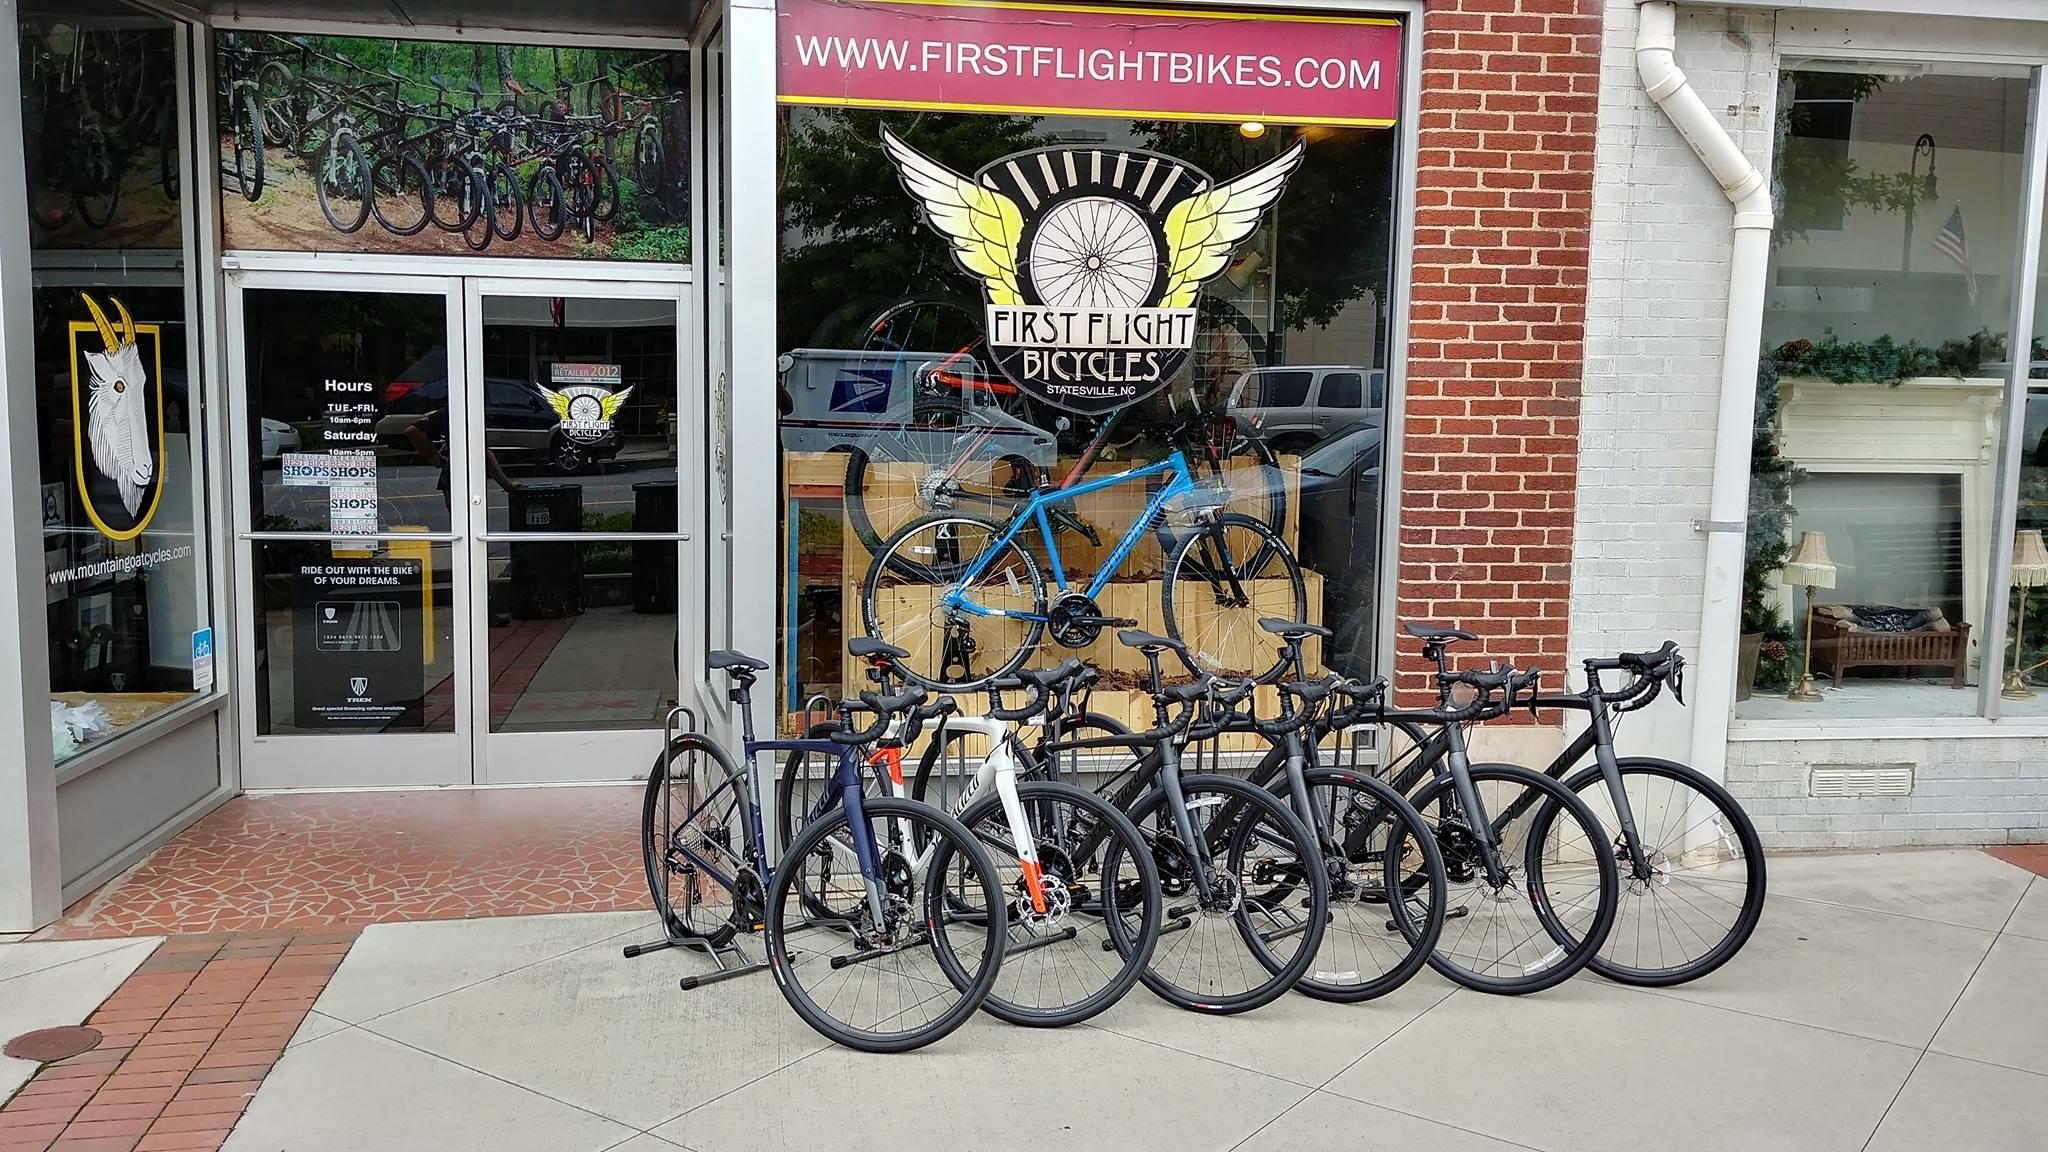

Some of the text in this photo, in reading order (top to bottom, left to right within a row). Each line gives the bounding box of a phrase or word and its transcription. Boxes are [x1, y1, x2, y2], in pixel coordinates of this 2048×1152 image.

[794, 34, 1381, 91] WWW.FIRSTFLIGHTBIKES.COM
[994, 310, 1194, 346] FIRST FLIGHT
[554, 366, 619, 377] RETAILER 2012
[1023, 350, 1161, 382] BICYCLES
[325, 379, 373, 392] Hours
[1046, 384, 1136, 396] STATESVILLE, NC
[327, 403, 378, 412] TUE.-FRI.
[329, 416, 371, 425] 10am-6pm
[561, 420, 609, 429] FIRST FLIGHT
[323, 430, 377, 443] Saturday
[328, 448, 374, 456] 10am-5pm
[283, 465, 330, 476] SHOPS
[330, 467, 376, 478] SHOPS
[331, 499, 377, 509] SHOPS
[50, 545, 192, 585] www.mountaingoatcycles.com
[301, 566, 413, 575] RIDE OUT WITH THE BIKE
[313, 576, 401, 585] OF YOUR DREAMS.
